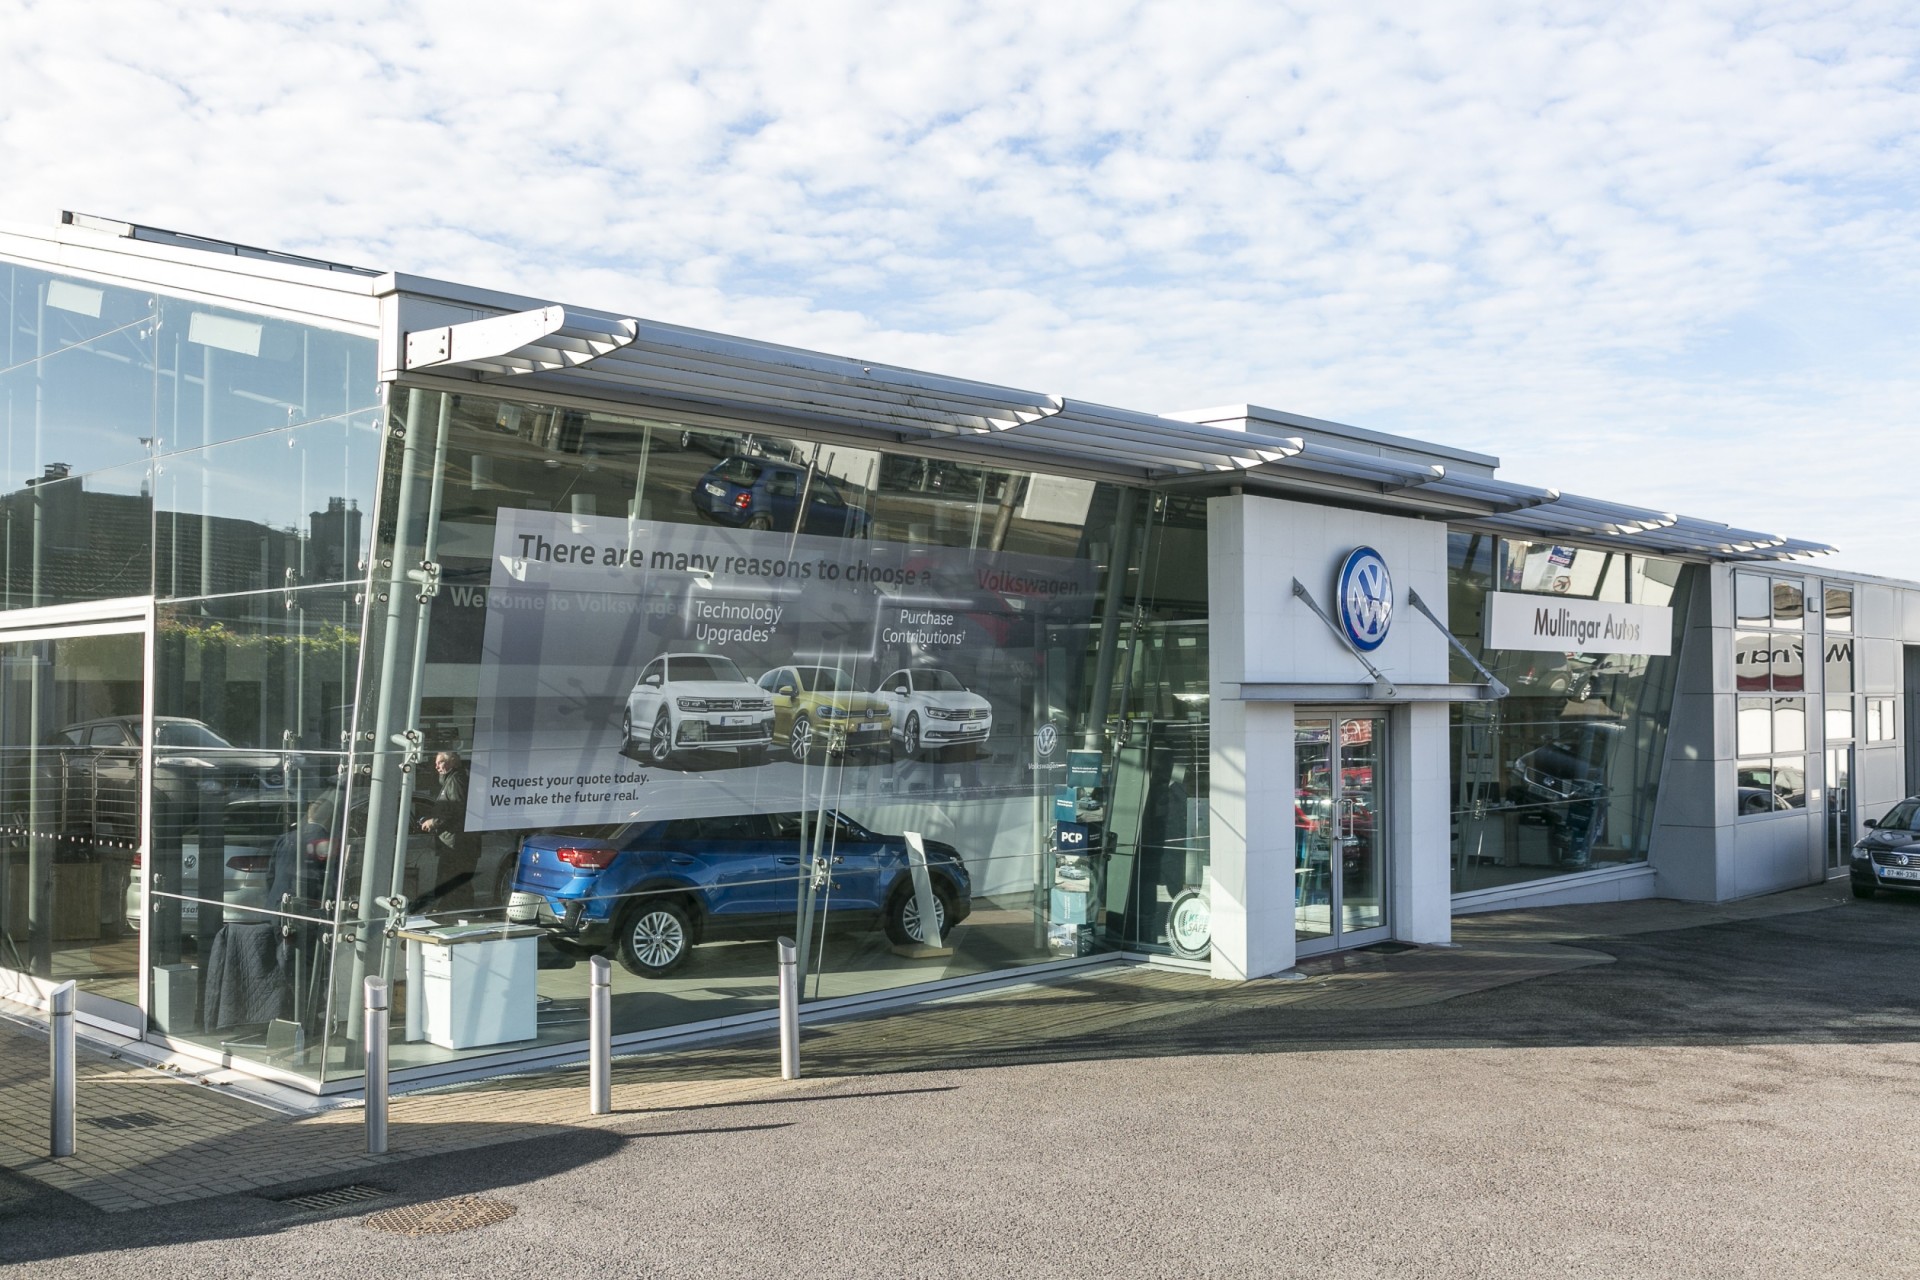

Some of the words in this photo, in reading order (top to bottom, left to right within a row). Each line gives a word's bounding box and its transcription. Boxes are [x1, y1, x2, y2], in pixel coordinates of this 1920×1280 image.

[518, 534, 595, 565] There
[602, 546, 644, 568] are
[650, 550, 719, 578] many
[724, 554, 811, 579] reasons
[817, 559, 840, 581] to
[845, 559, 916, 585] choose
[921, 570, 932, 587] a
[977, 568, 1082, 598] Volkswagen.
[450, 586, 545, 611] Welcome
[551, 593, 569, 612] to
[576, 593, 686, 620] Volkswage
[695, 600, 783, 625] Technology
[900, 609, 954, 626] Purchase
[1534, 607, 1601, 646] Mullingar
[1603, 613, 1640, 641] Autos
[491, 776, 544, 790] Request
[546, 776, 574, 789] your
[576, 773, 612, 788] quote
[614, 772, 650, 785] today.
[490, 794, 511, 806] We
[514, 793, 548, 806] make
[551, 791, 571, 804] the
[574, 791, 610, 803] future
[614, 789, 639, 801] real.
[1061, 831, 1083, 843] PCP
[1187, 922, 1209, 934] SAFE
